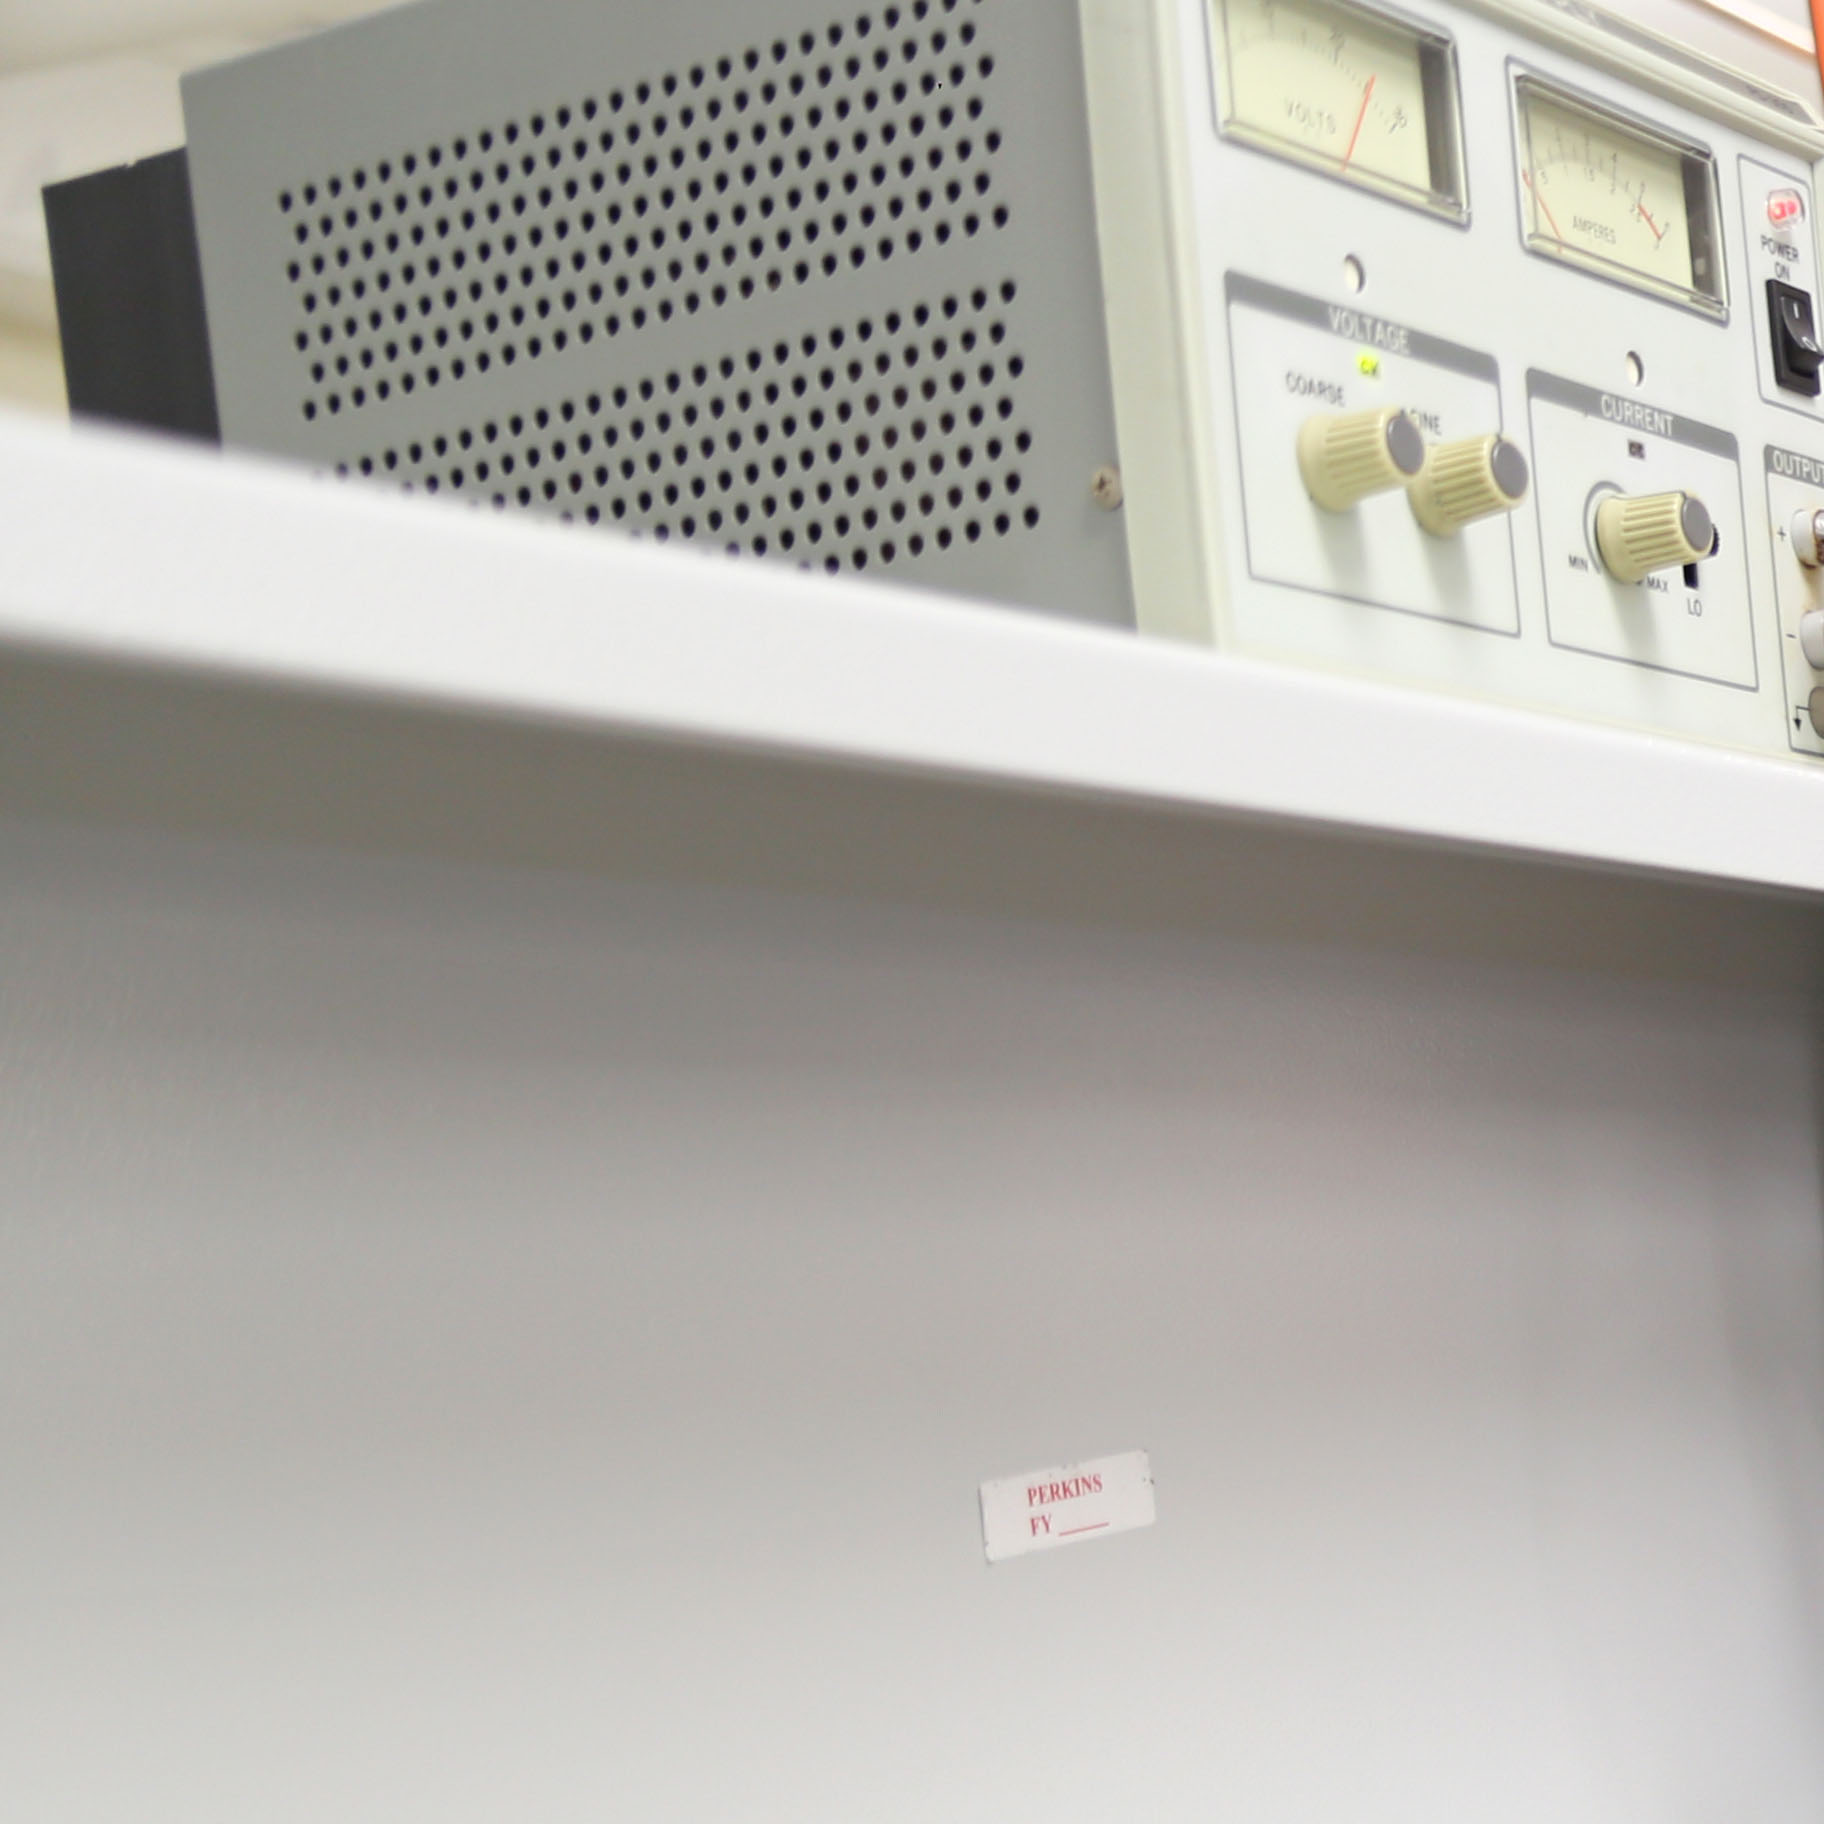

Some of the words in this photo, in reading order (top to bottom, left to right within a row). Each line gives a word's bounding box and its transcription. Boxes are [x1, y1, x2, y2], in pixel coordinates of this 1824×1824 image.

[1760, 234, 1799, 264] POWER
[1774, 261, 1790, 281] ON
[1328, 305, 1410, 356] VOLTAGE
[1285, 371, 1346, 408] COARSE
[1600, 394, 1674, 437] CURRENT
[1568, 554, 1589, 573] MIN
[1646, 576, 1670, 593] MAX
[1686, 597, 1703, 617] LO
[1027, 1473, 1103, 1507] PERKINS
[1029, 1514, 1053, 1537] FY
